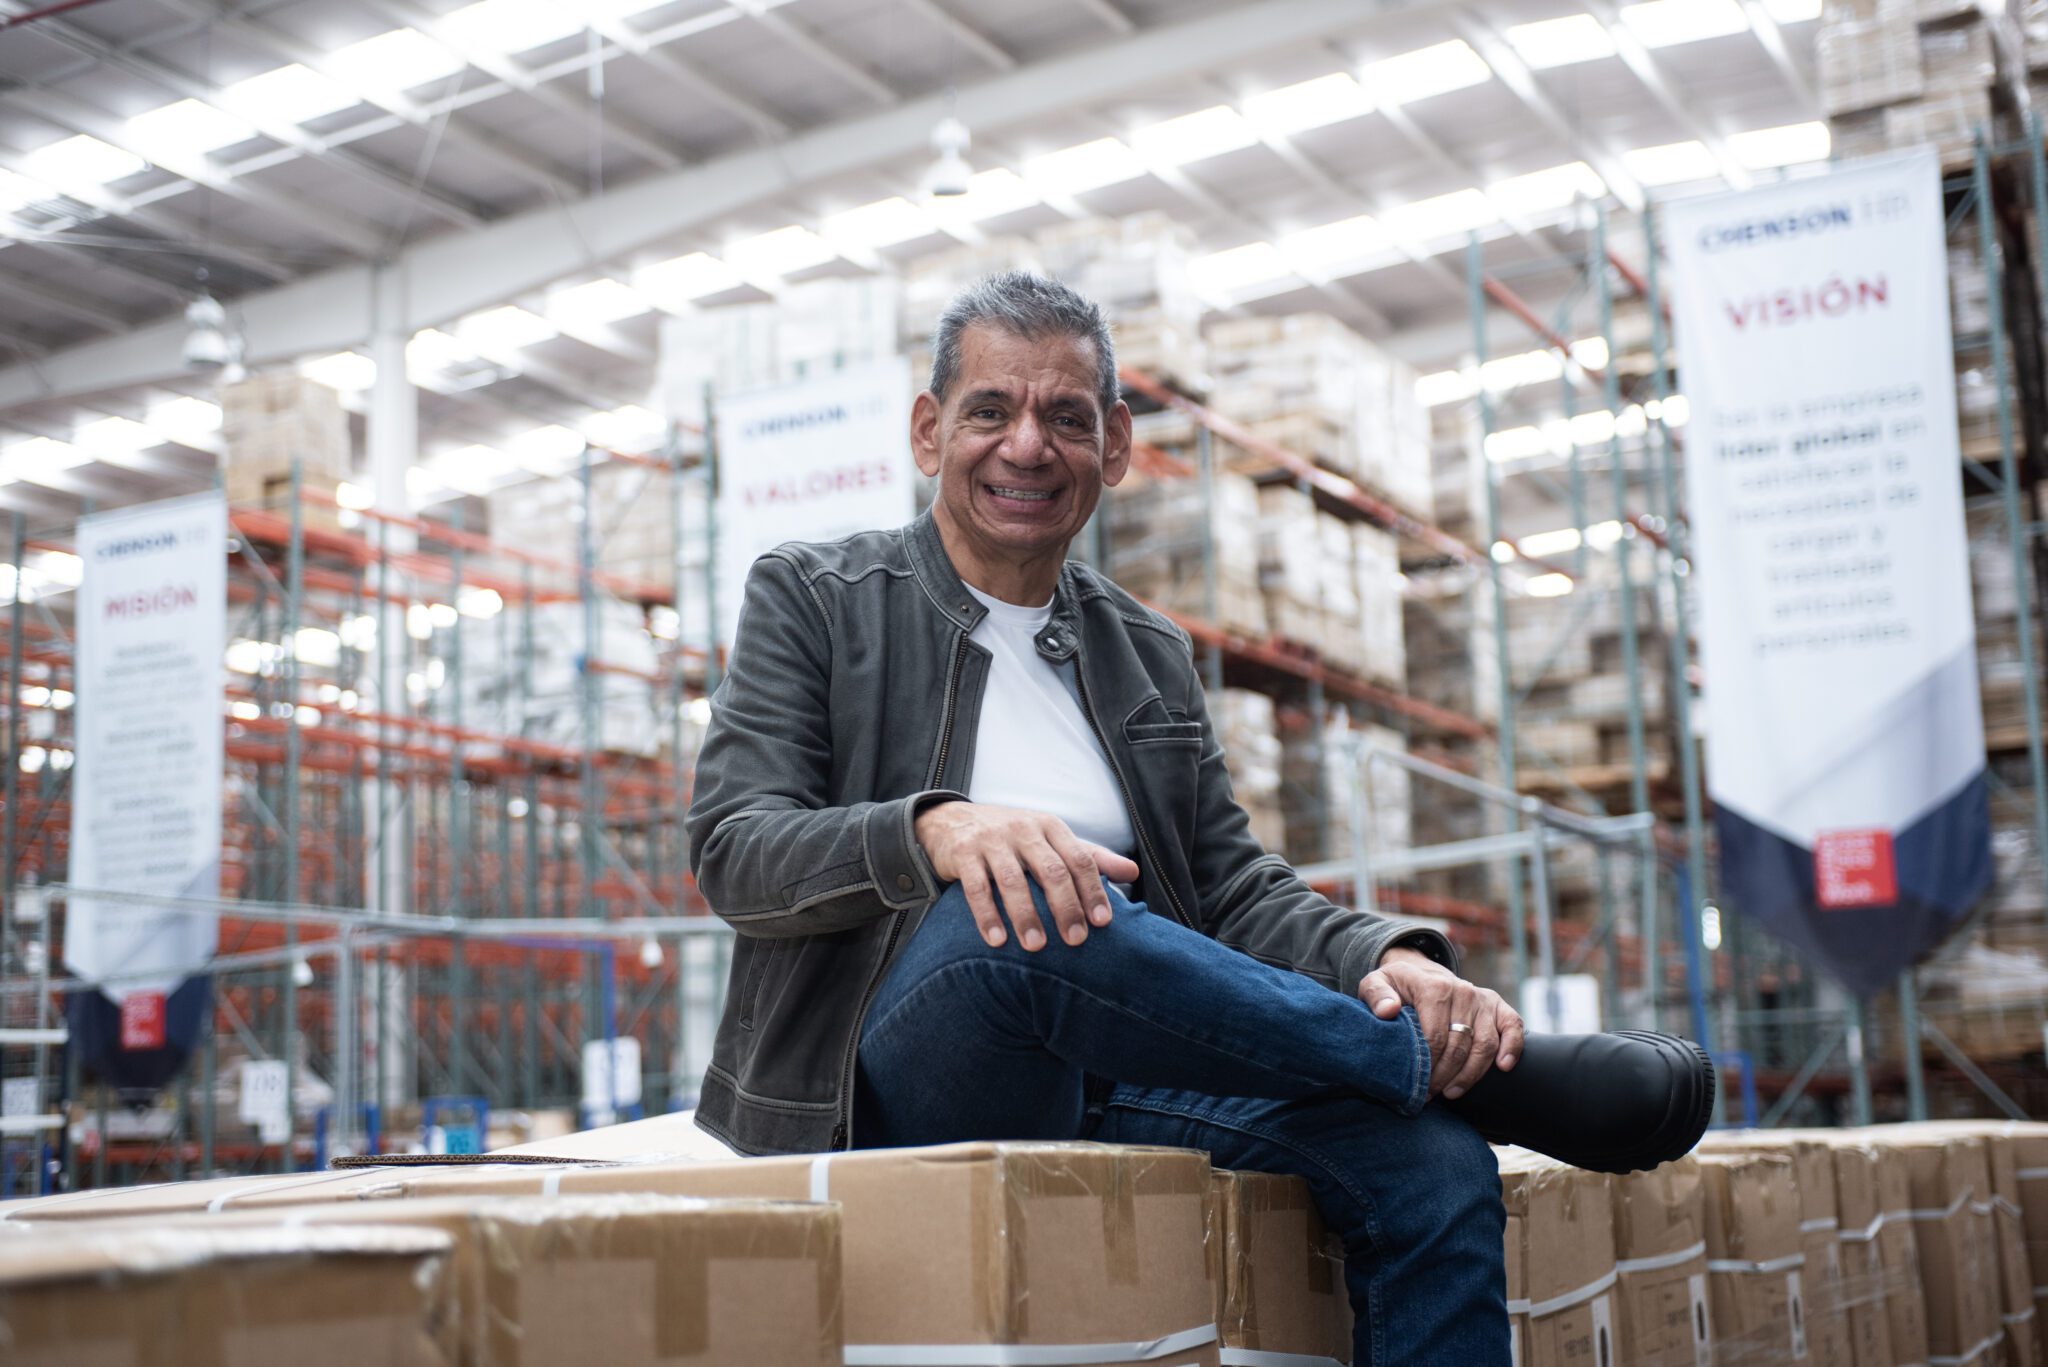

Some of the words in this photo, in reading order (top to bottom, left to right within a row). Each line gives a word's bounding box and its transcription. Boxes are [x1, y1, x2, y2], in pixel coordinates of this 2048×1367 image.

[1726, 276, 1889, 330] VISIÓN
[745, 462, 890, 507] VALORES
[103, 580, 198, 621] MISIÓN
